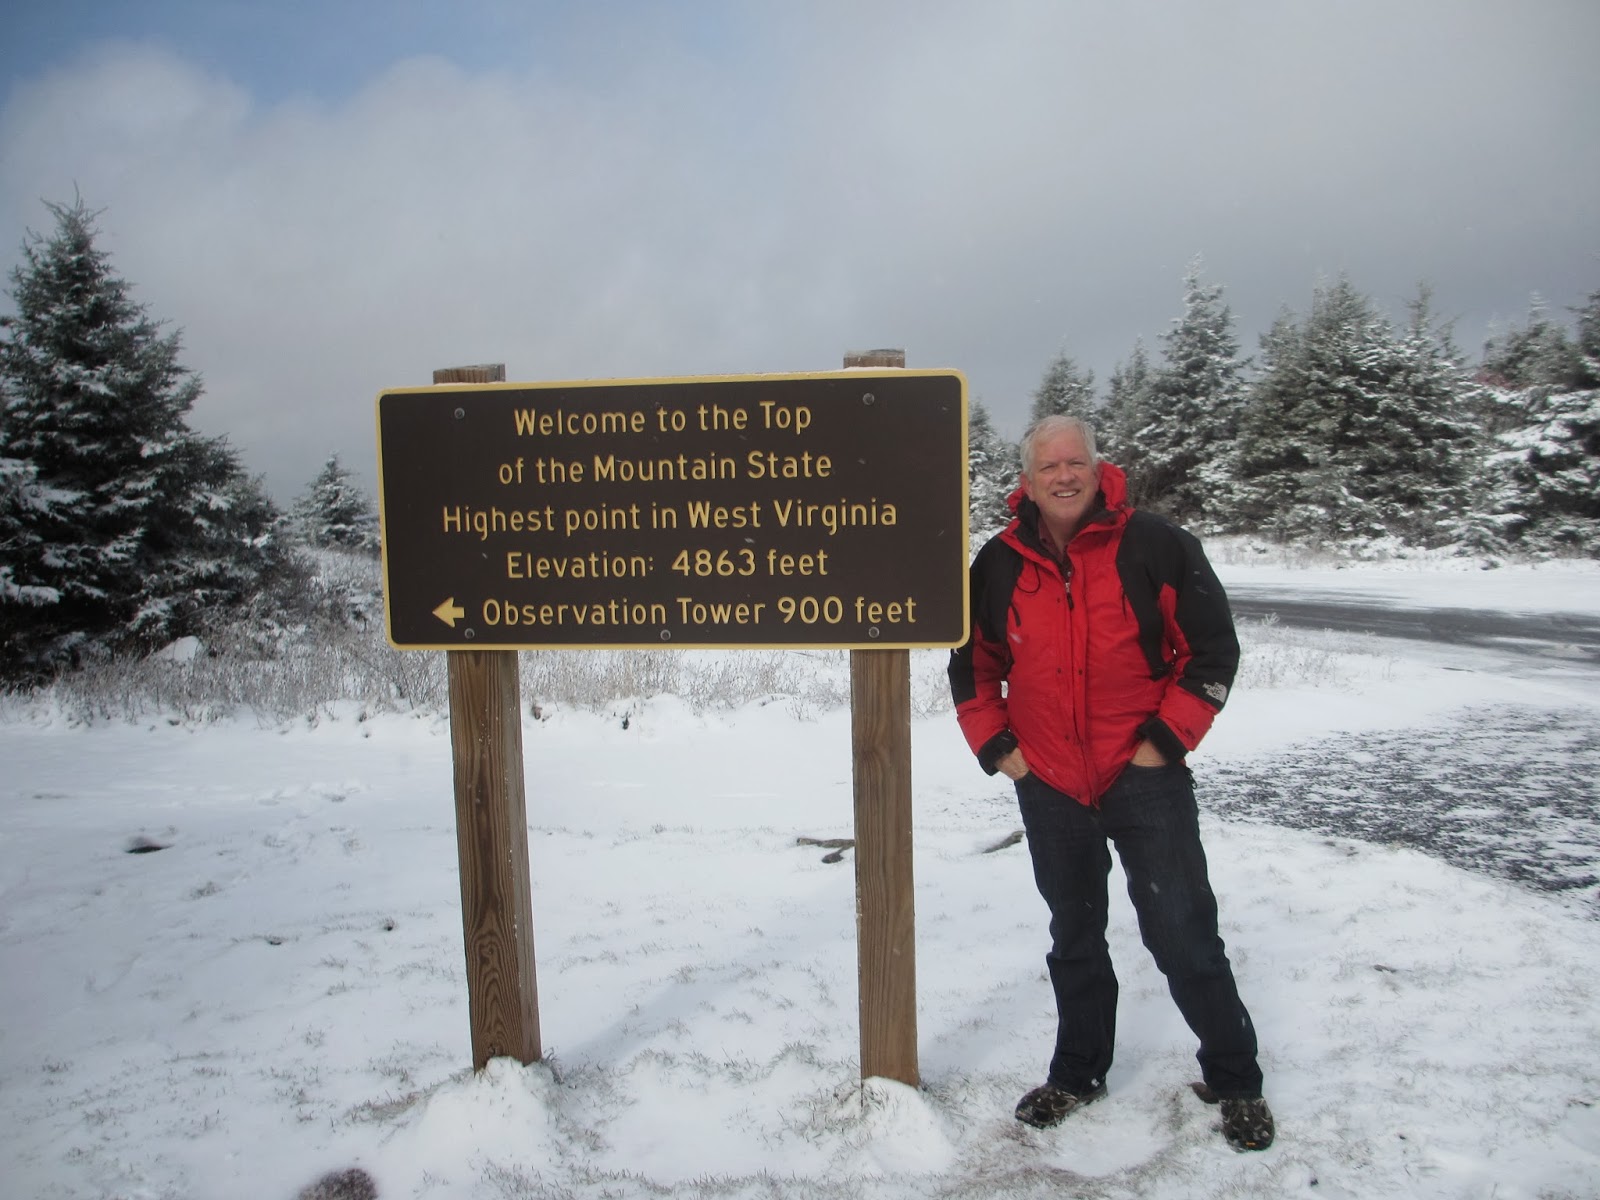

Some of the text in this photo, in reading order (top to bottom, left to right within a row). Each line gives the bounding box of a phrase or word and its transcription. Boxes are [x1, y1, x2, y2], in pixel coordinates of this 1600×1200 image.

[513, 400, 812, 436] Welcome to the Top
[498, 450, 832, 485] of the Mountain State
[442, 498, 897, 541] Highest point in West Virginia
[506, 548, 829, 579] Elevation: 4863 feet
[482, 595, 917, 627] Observation Tower 900 feet
